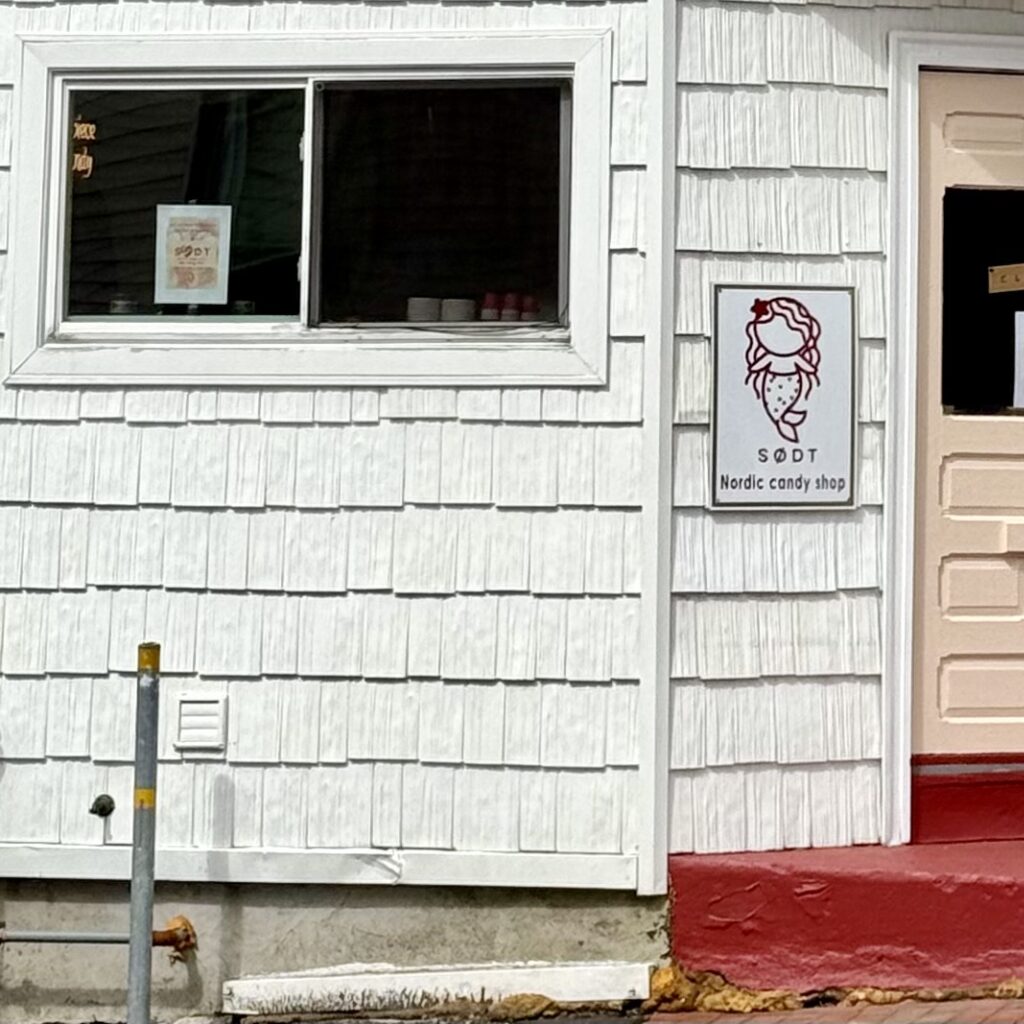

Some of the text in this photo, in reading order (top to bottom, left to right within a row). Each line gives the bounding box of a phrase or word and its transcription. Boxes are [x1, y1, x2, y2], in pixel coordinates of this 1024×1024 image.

[758, 447, 818, 464] SØDT
[720, 473, 846, 493] Nordic candy shop
